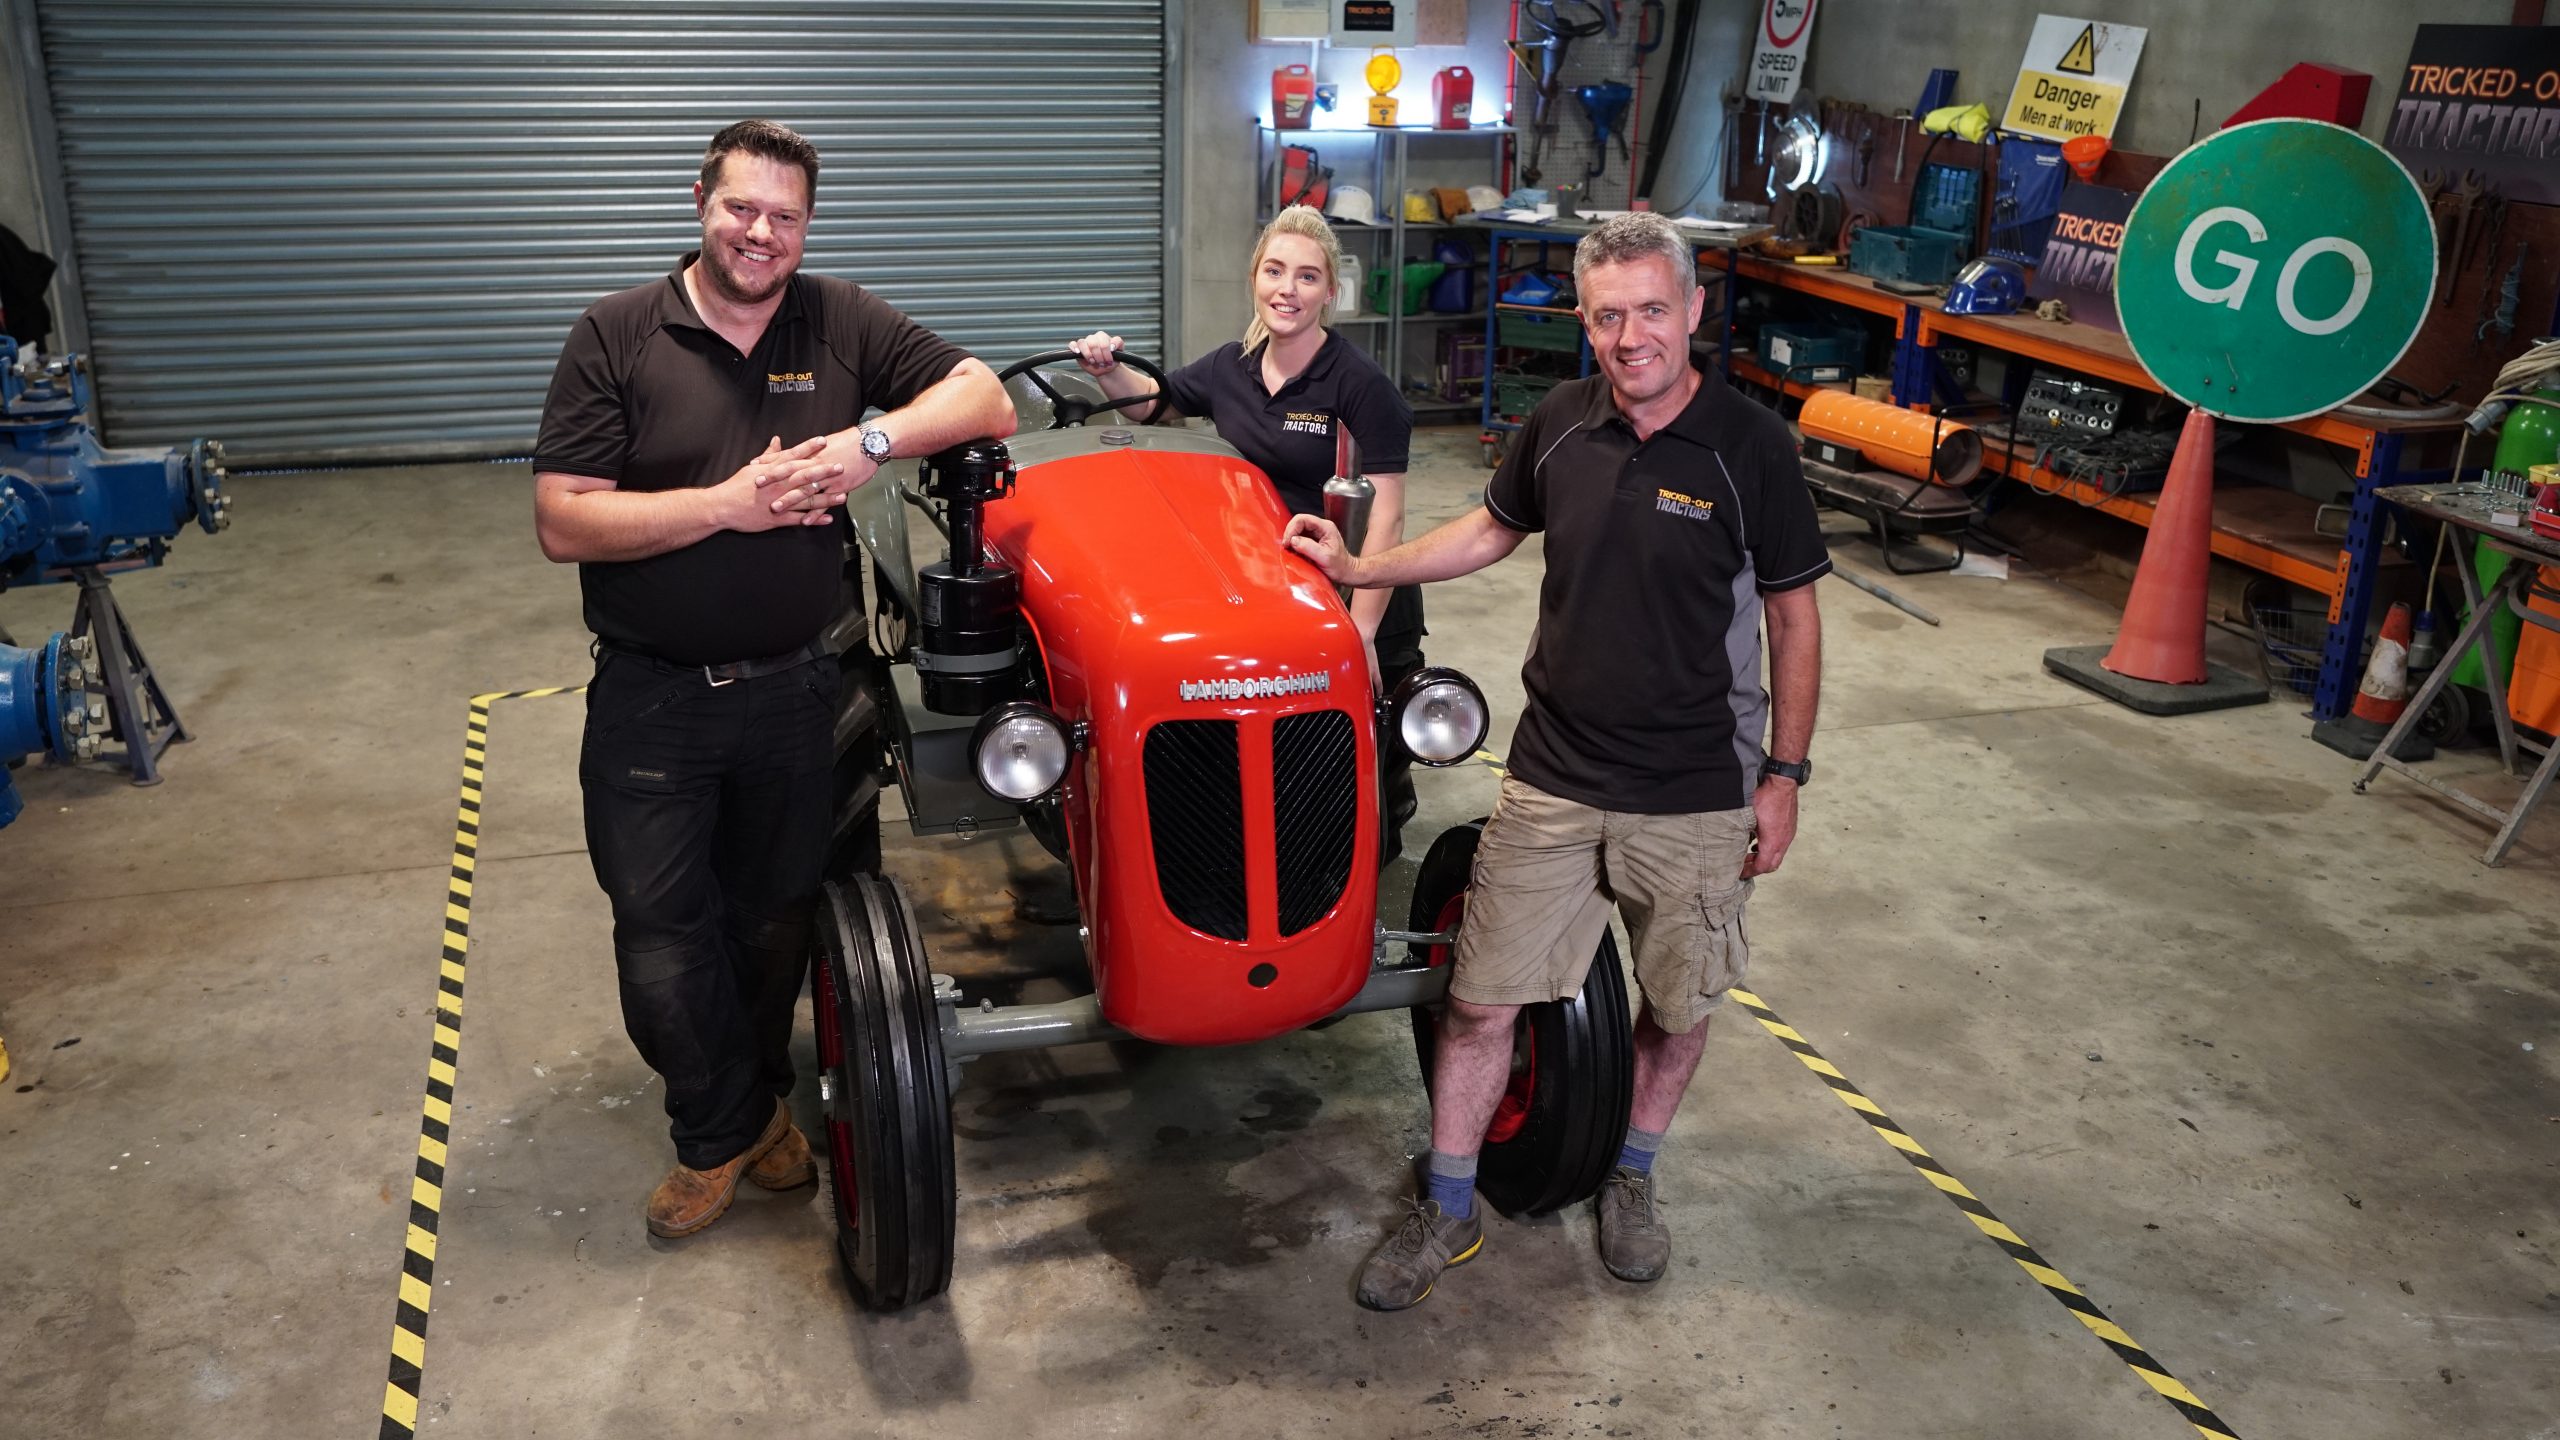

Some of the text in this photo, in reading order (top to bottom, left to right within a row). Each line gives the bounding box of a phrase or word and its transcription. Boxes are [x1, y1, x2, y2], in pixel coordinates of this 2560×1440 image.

[1758, 52, 1797, 72] SPEED
[1757, 75, 1789, 94] LIMIT
[2034, 78, 2102, 112] Danger
[2409, 65, 2560, 100] TRICKED-O
[2019, 105, 2097, 136] Men at work
[2392, 99, 2560, 158] TRACTOR
[2055, 212, 2125, 249] TRICKED
[2040, 239, 2116, 294] TRACT
[2174, 206, 2373, 336] GO
[1283, 420, 1327, 434] TRACTORS
[1656, 497, 1711, 520] TRACTORS
[1180, 670, 1329, 700] LAMBORGHINI
